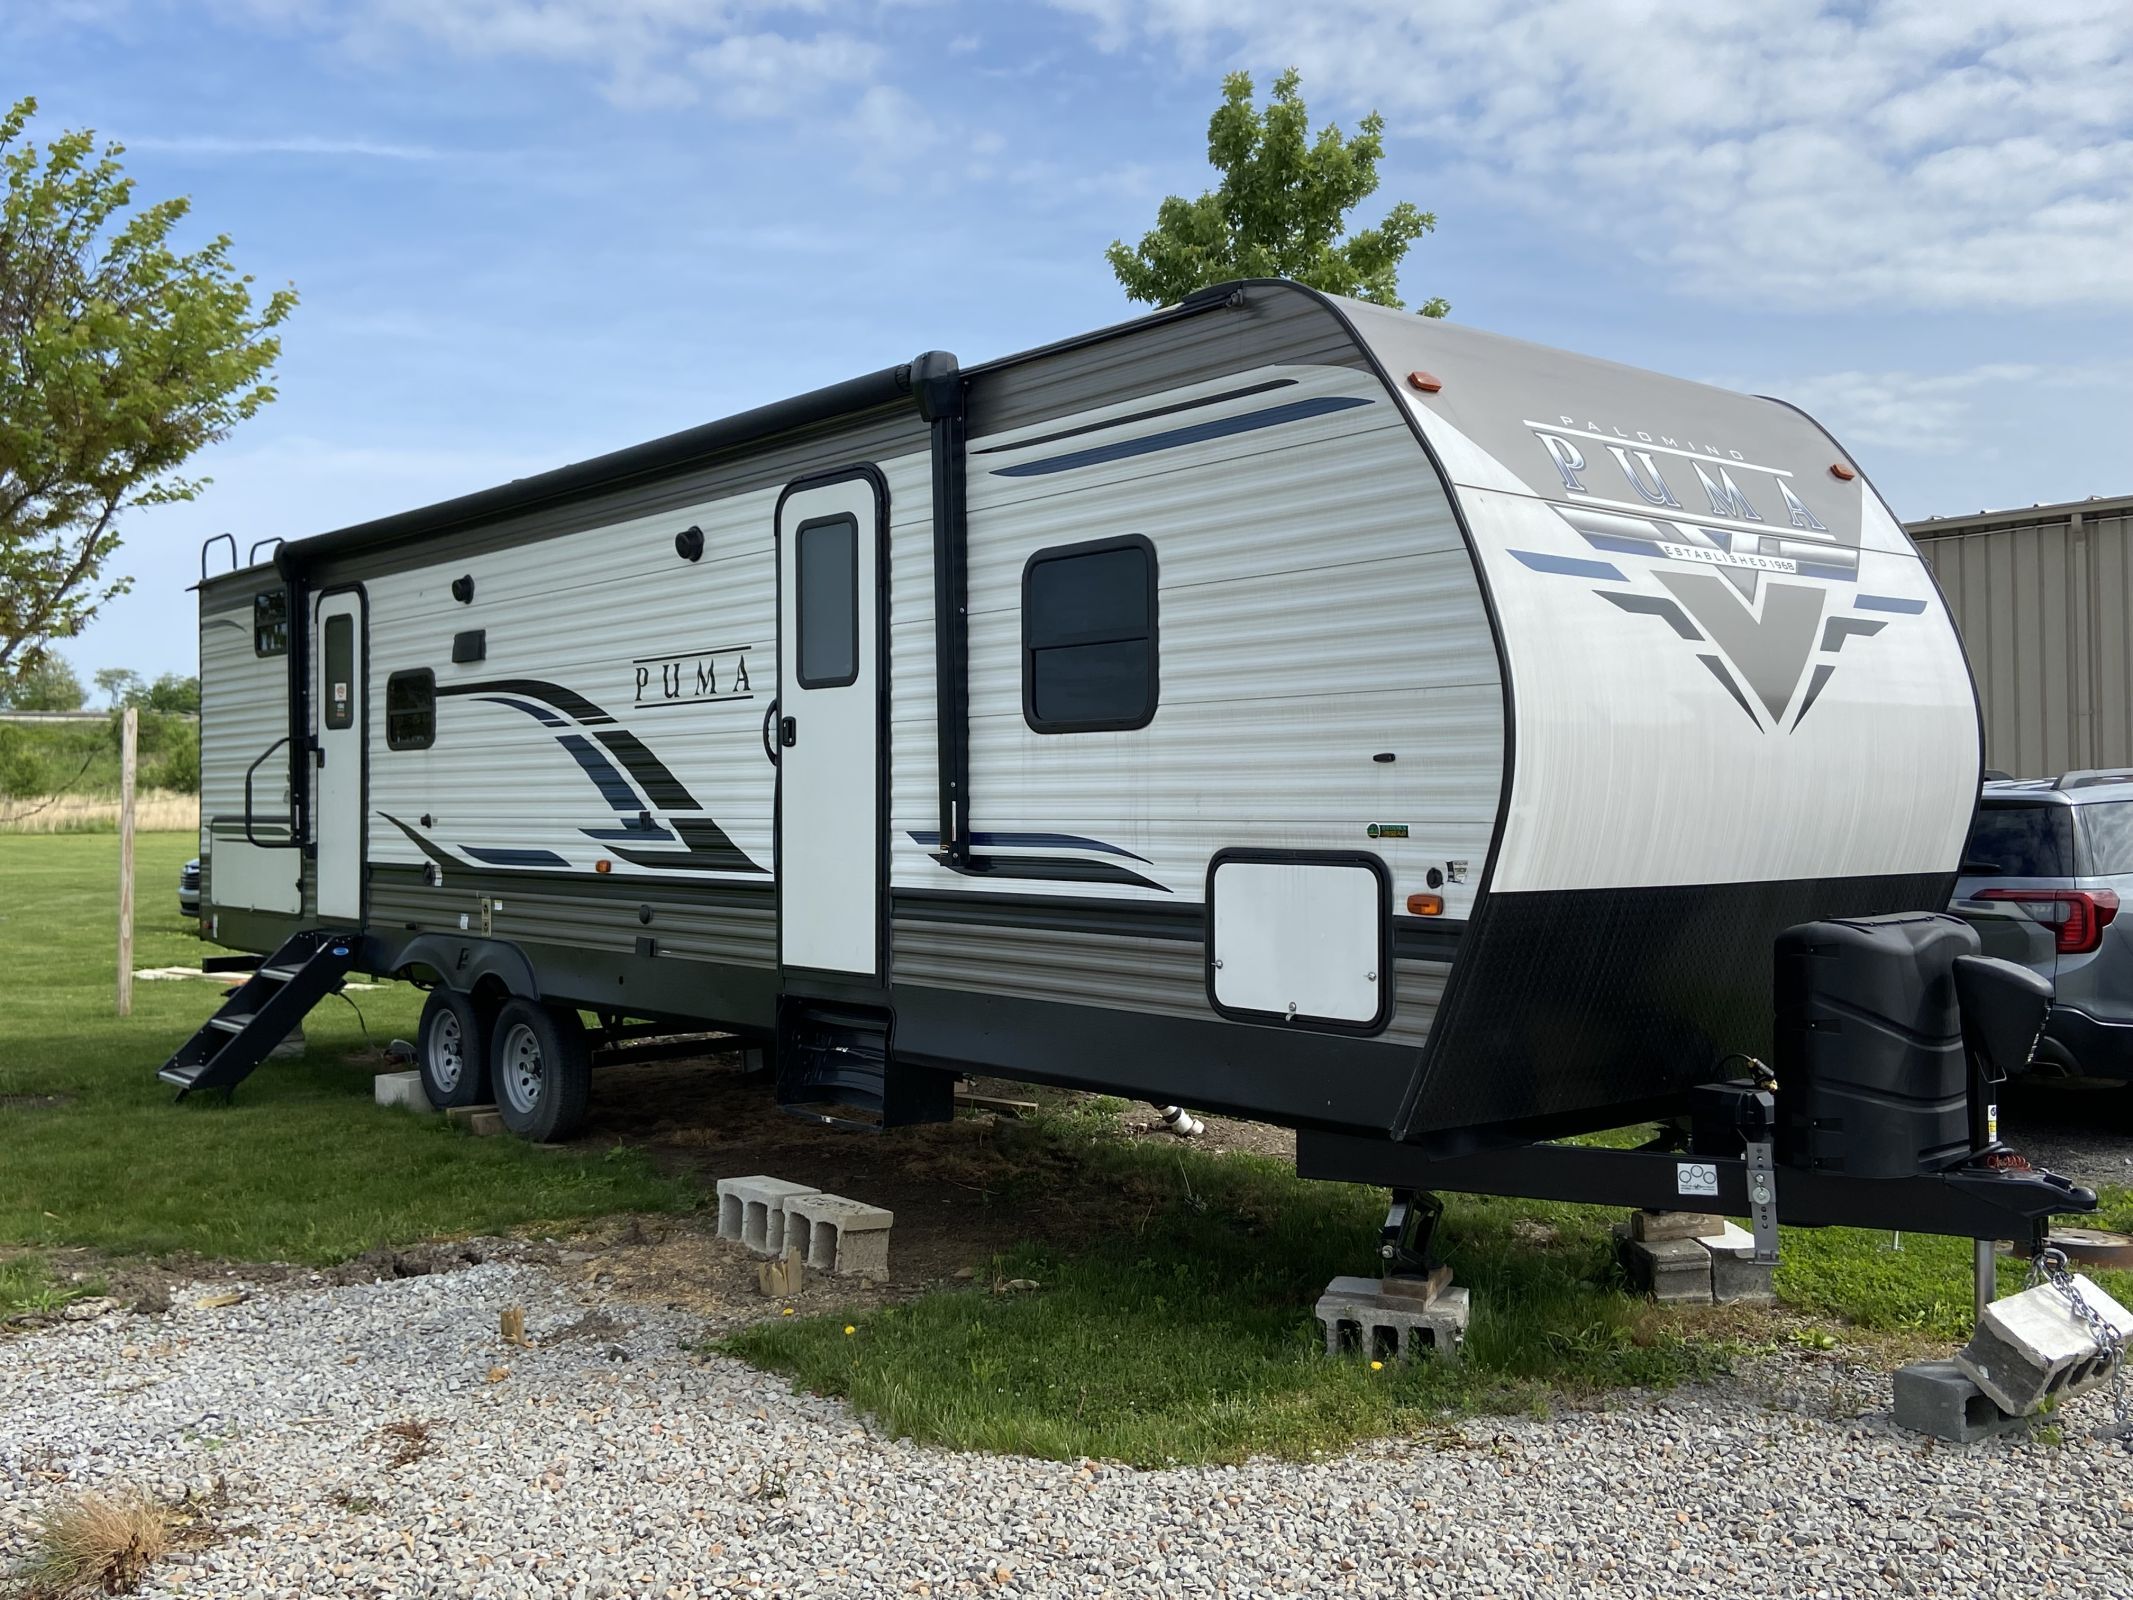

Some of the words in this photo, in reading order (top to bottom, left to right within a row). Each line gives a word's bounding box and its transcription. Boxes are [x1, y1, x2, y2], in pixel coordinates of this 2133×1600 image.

[1559, 415, 1744, 461] PALOMINO
[1533, 431, 1828, 531] PUMA
[1664, 546, 1767, 567] ESTABLISHED
[1769, 560, 1795, 571] 1968
[635, 654, 751, 701] PUMA
